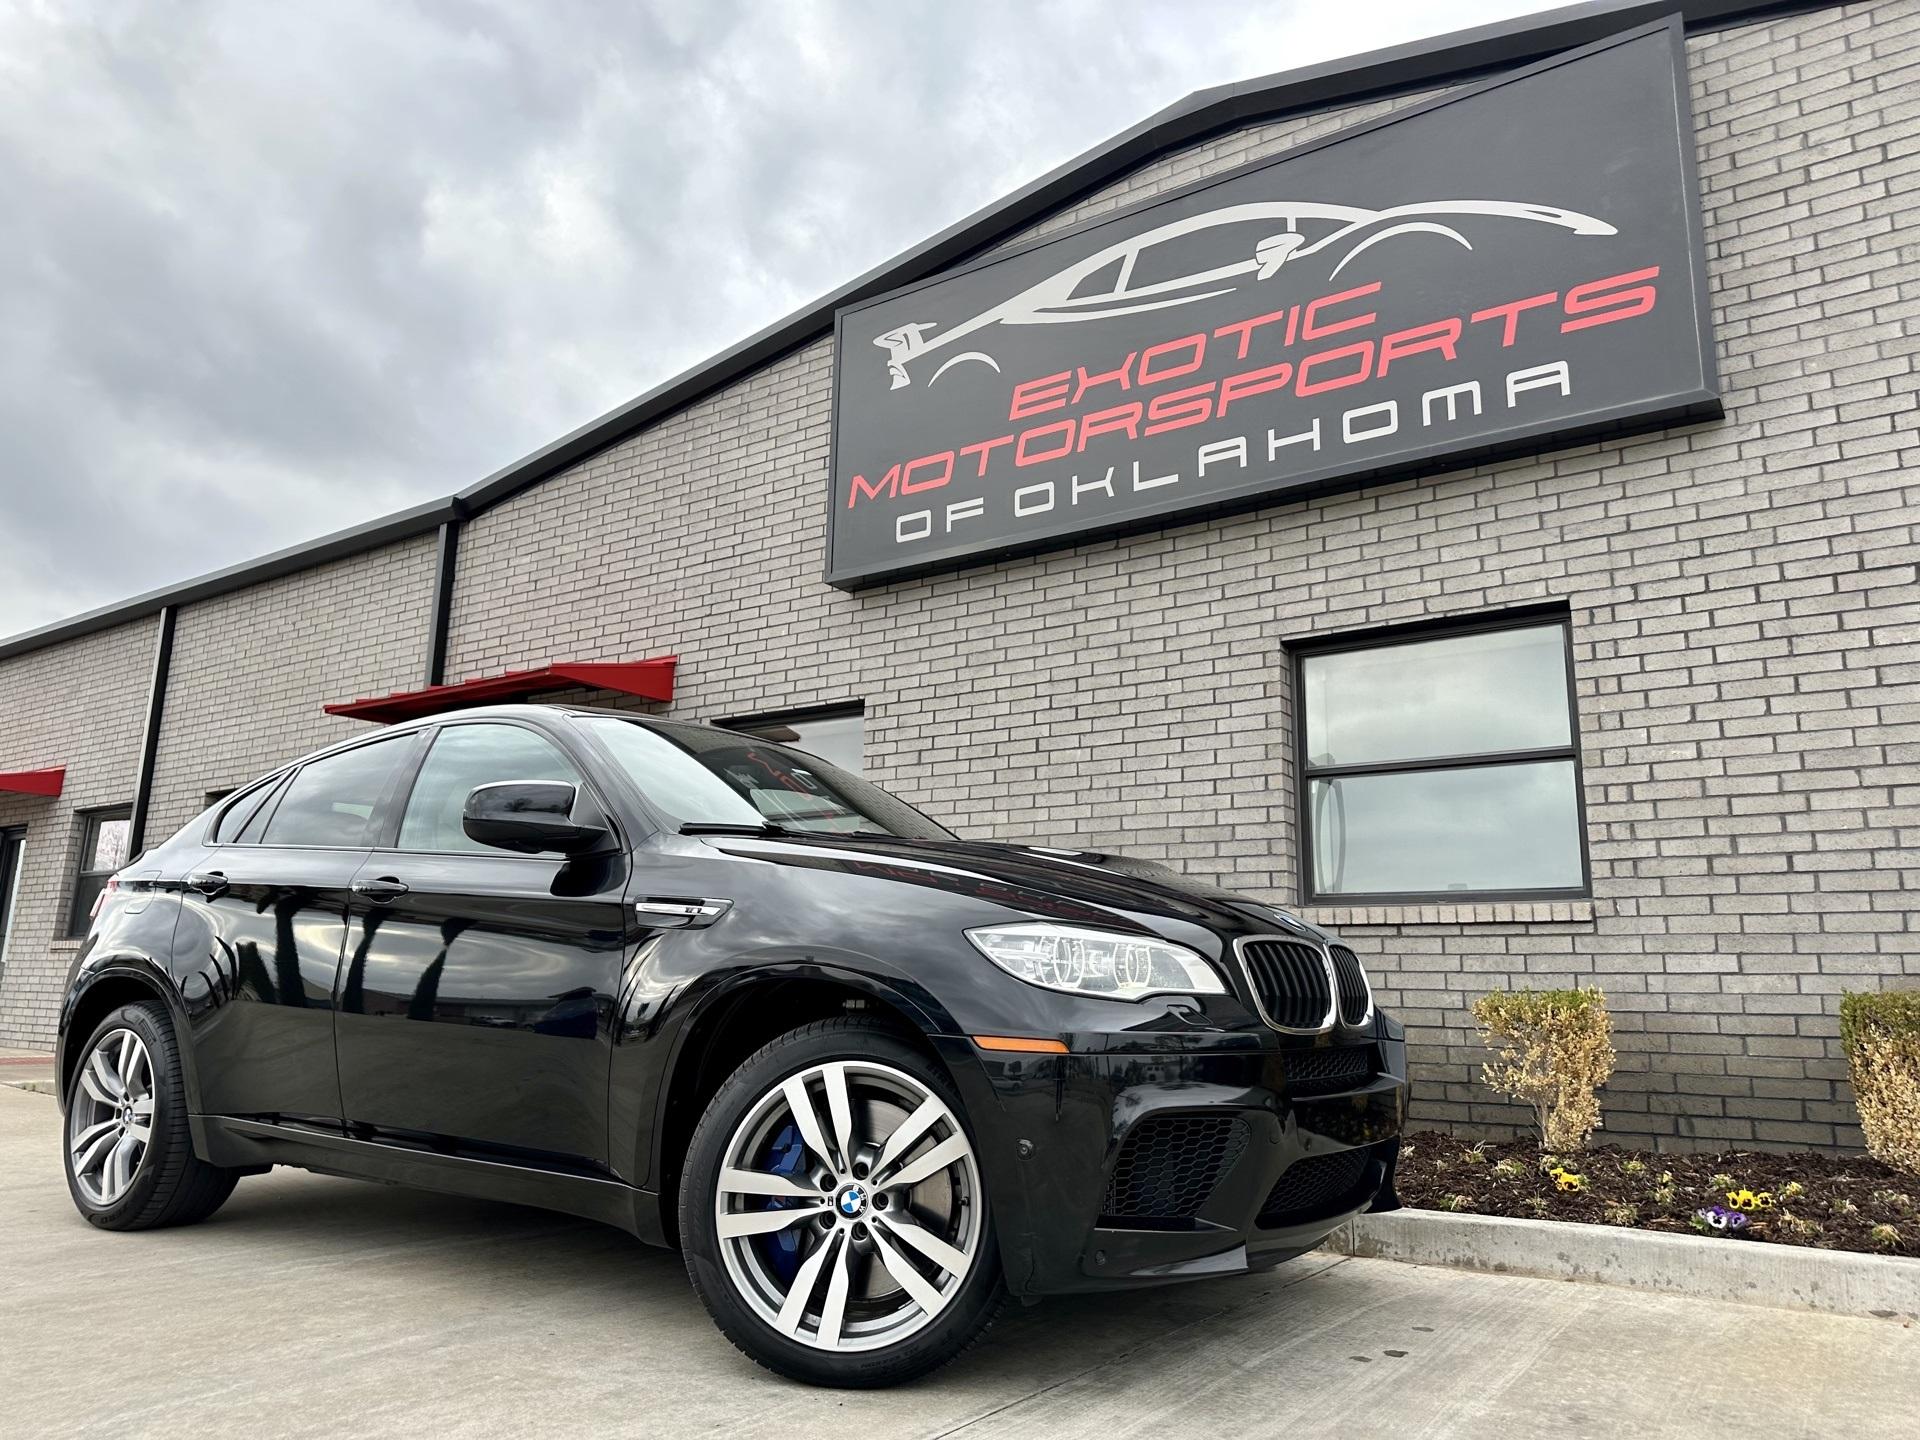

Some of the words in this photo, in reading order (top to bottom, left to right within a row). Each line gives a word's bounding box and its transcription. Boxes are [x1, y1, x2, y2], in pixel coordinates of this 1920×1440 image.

[848, 266, 1660, 507] MOTORSPORTS
[1008, 282, 1381, 420] EXOTIC
[895, 496, 984, 544] OF
[1014, 360, 1571, 518] OKLAHOMA
